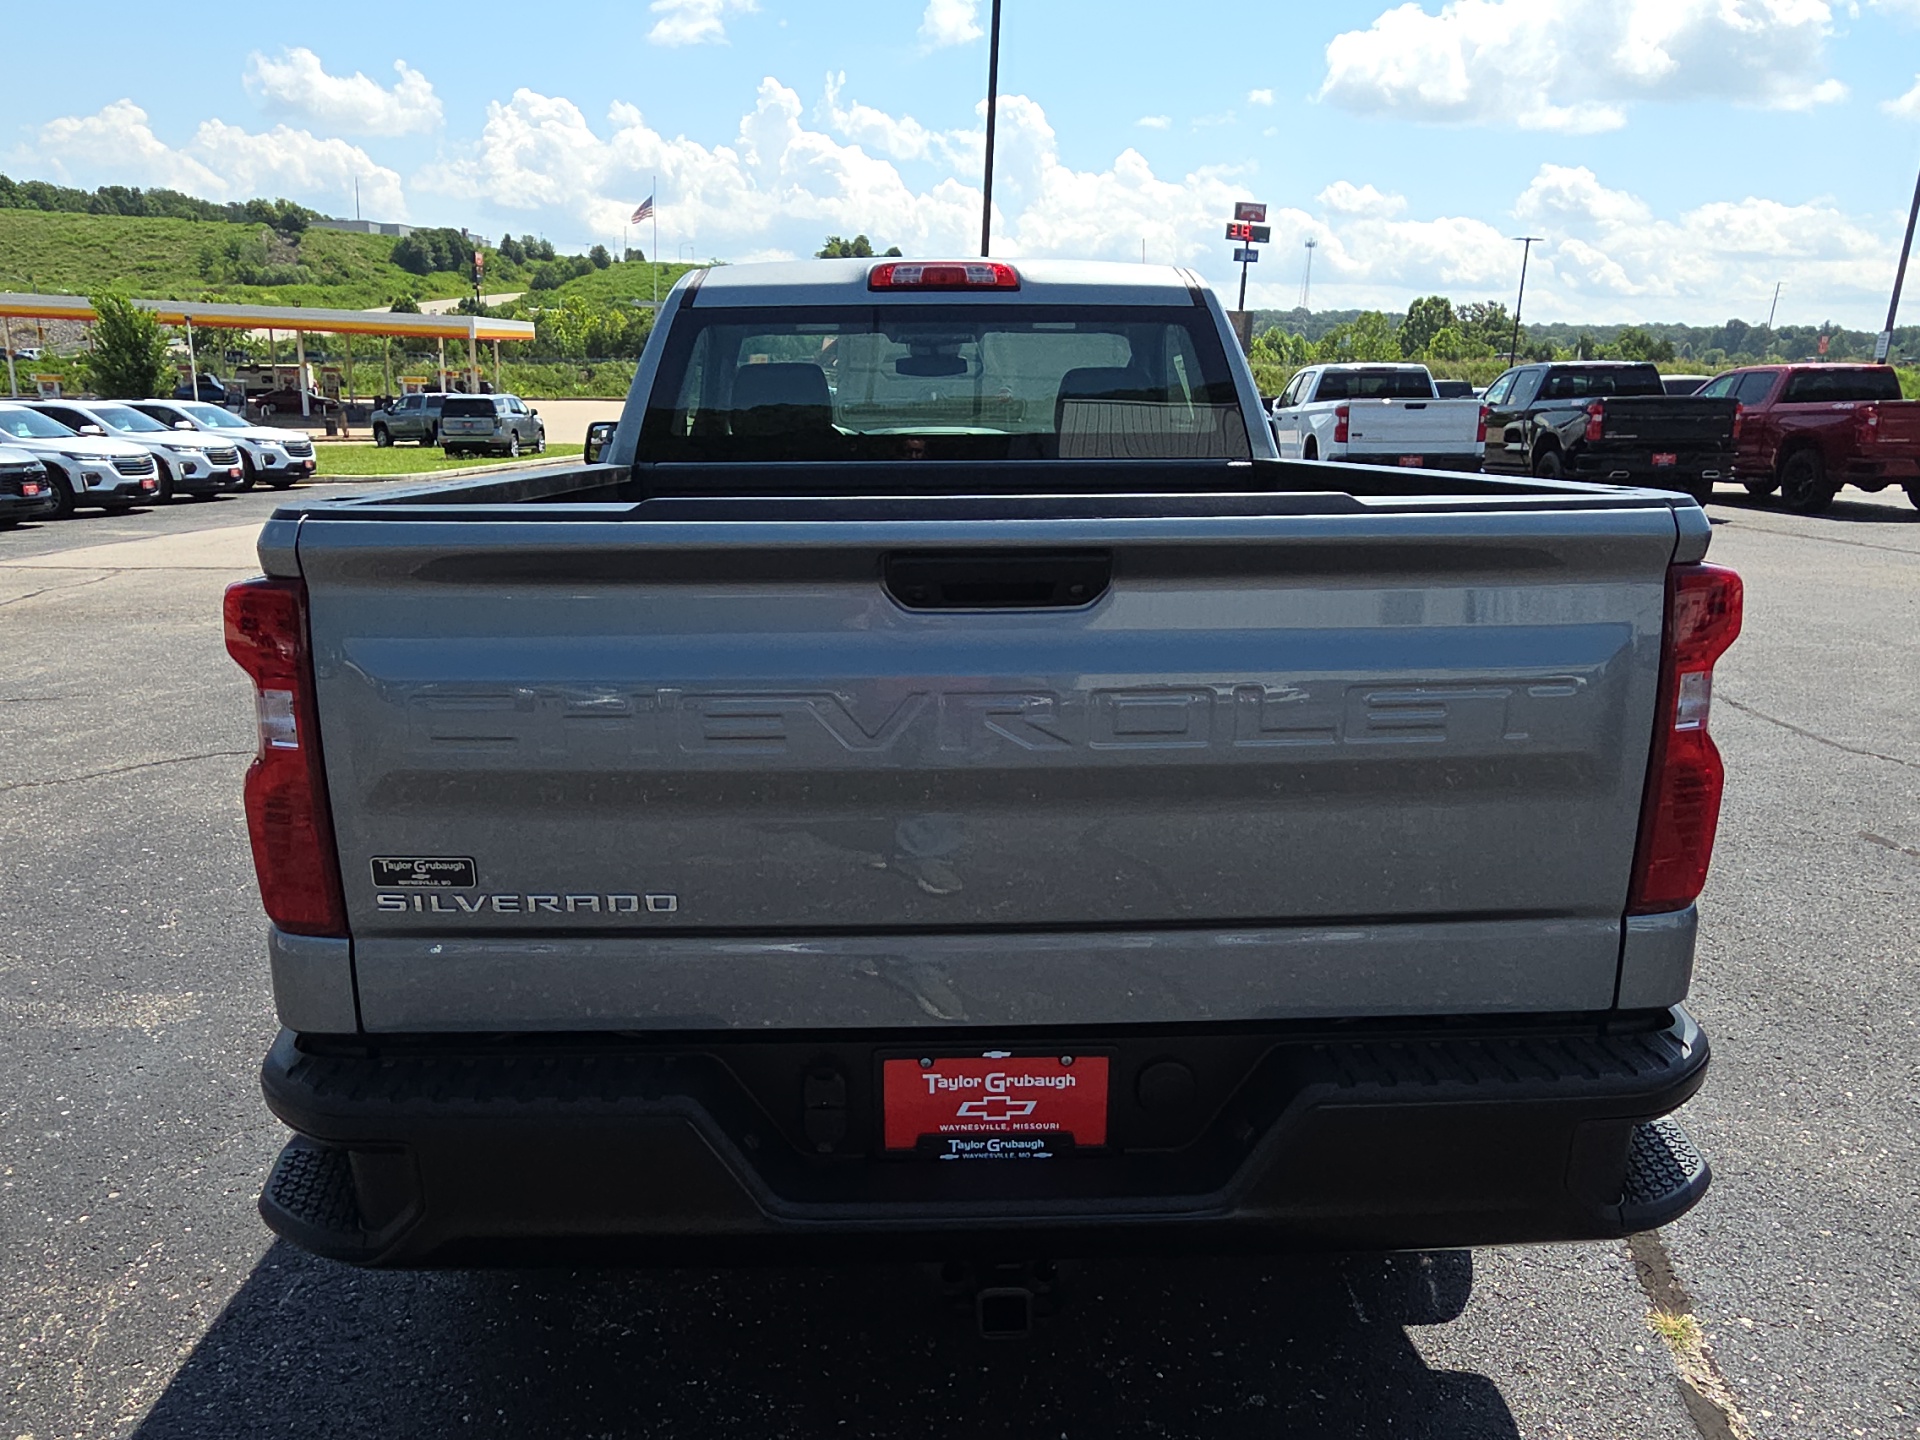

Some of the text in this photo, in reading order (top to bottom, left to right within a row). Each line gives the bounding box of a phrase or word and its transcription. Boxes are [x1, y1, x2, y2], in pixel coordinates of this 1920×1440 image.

[403, 674, 1588, 756] CHEVROLET
[378, 860, 466, 873] Taylor Grubaugh
[376, 893, 678, 913] SILVERADO
[922, 1072, 1076, 1094] Taylor Grubaugh
[939, 1122, 1060, 1132] WAYNESVILLE, MISSOURI
[947, 1138, 1045, 1153] Taylor Grubaugh
